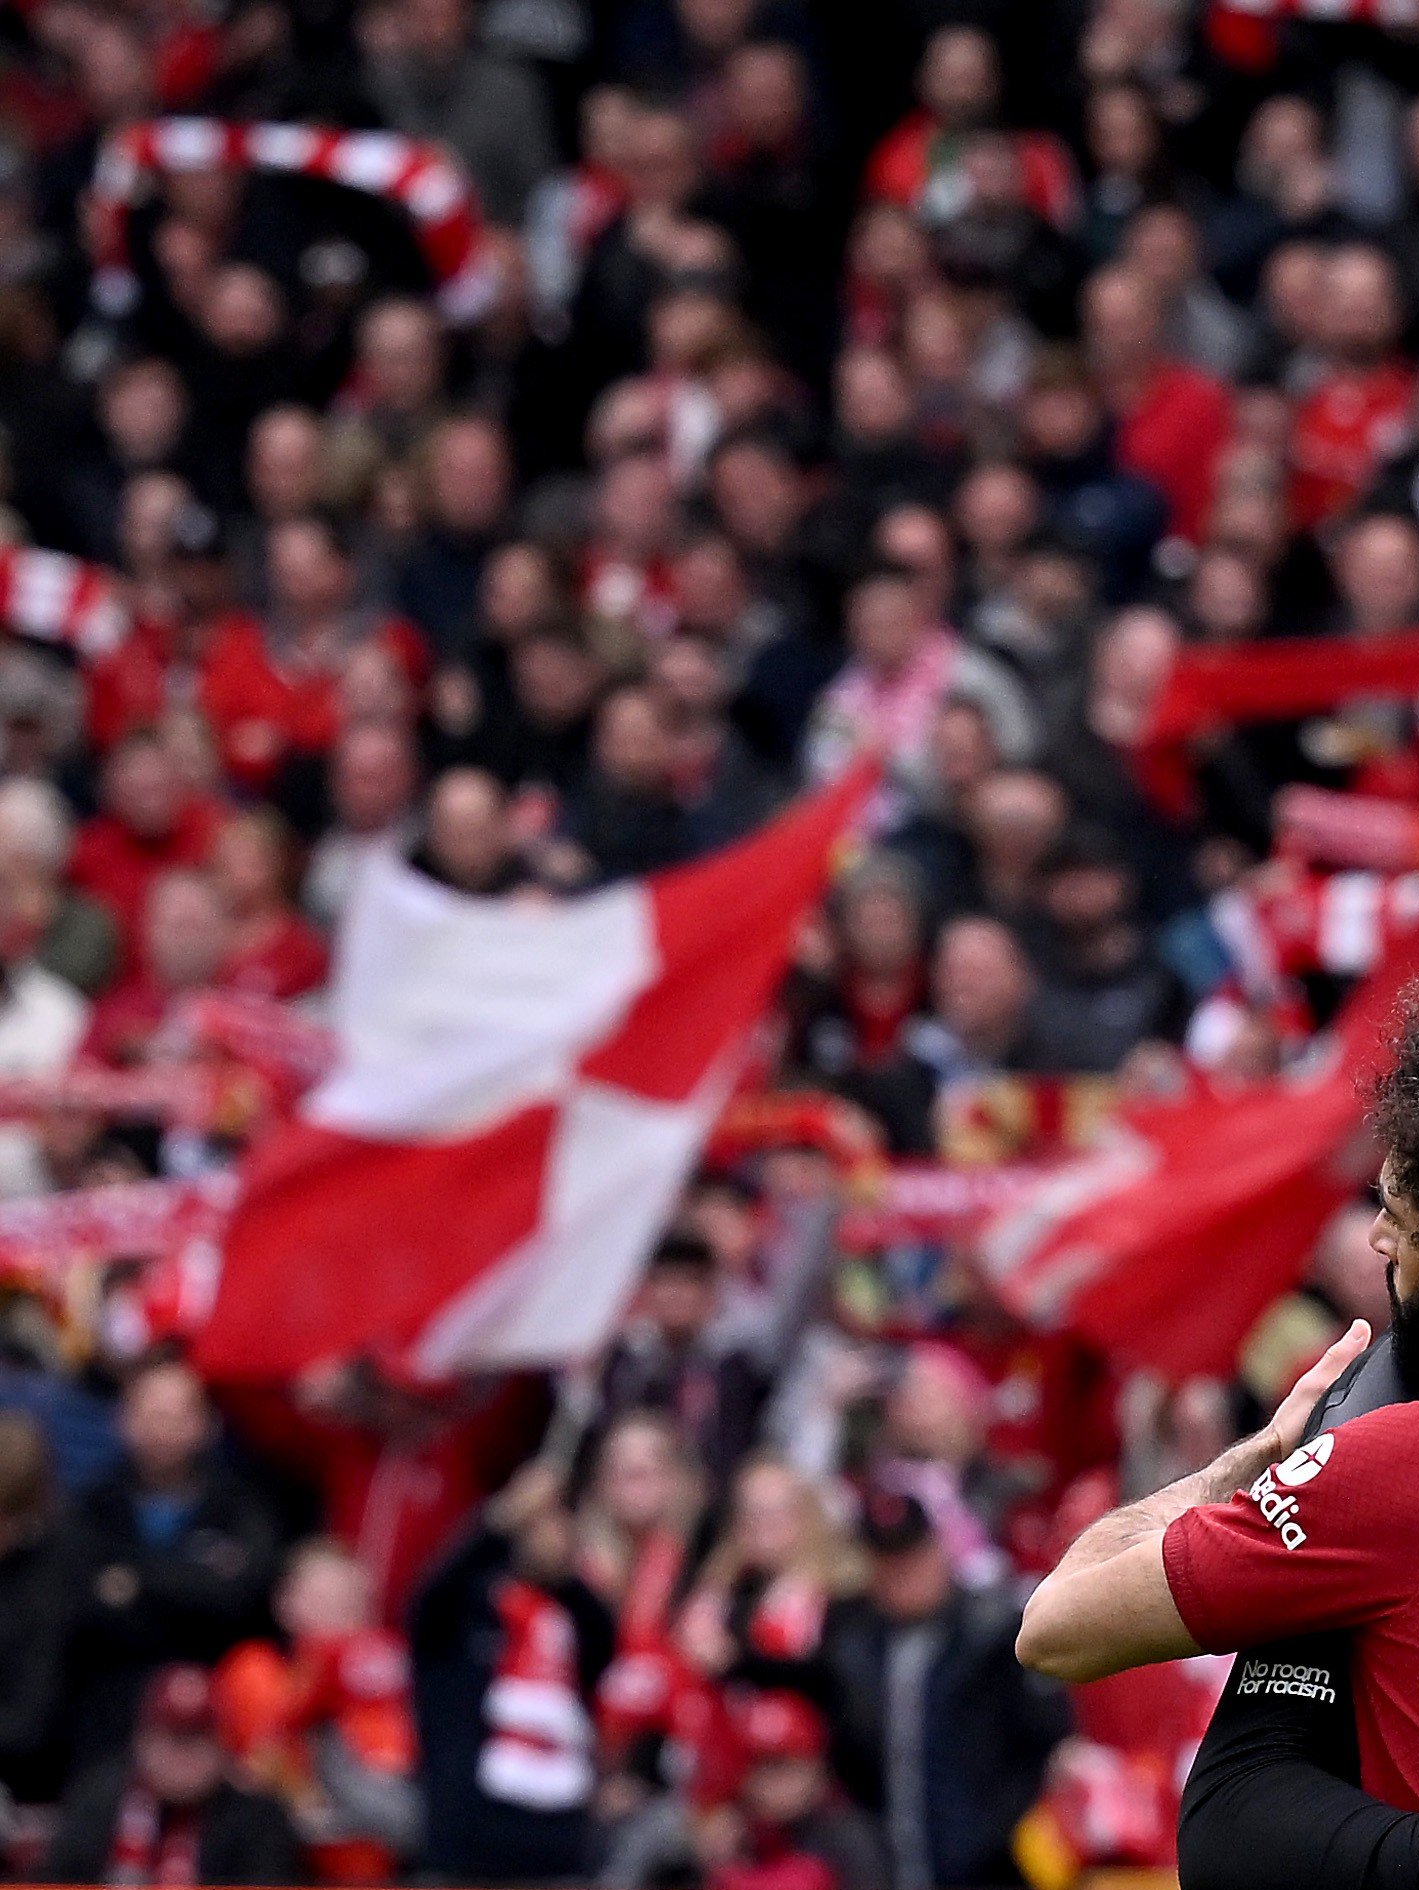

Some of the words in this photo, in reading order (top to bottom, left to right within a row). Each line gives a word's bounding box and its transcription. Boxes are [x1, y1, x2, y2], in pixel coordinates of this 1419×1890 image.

[1242, 1660, 1268, 1678] No
[1271, 1664, 1330, 1684] room
[1265, 1680, 1336, 1703] racism
